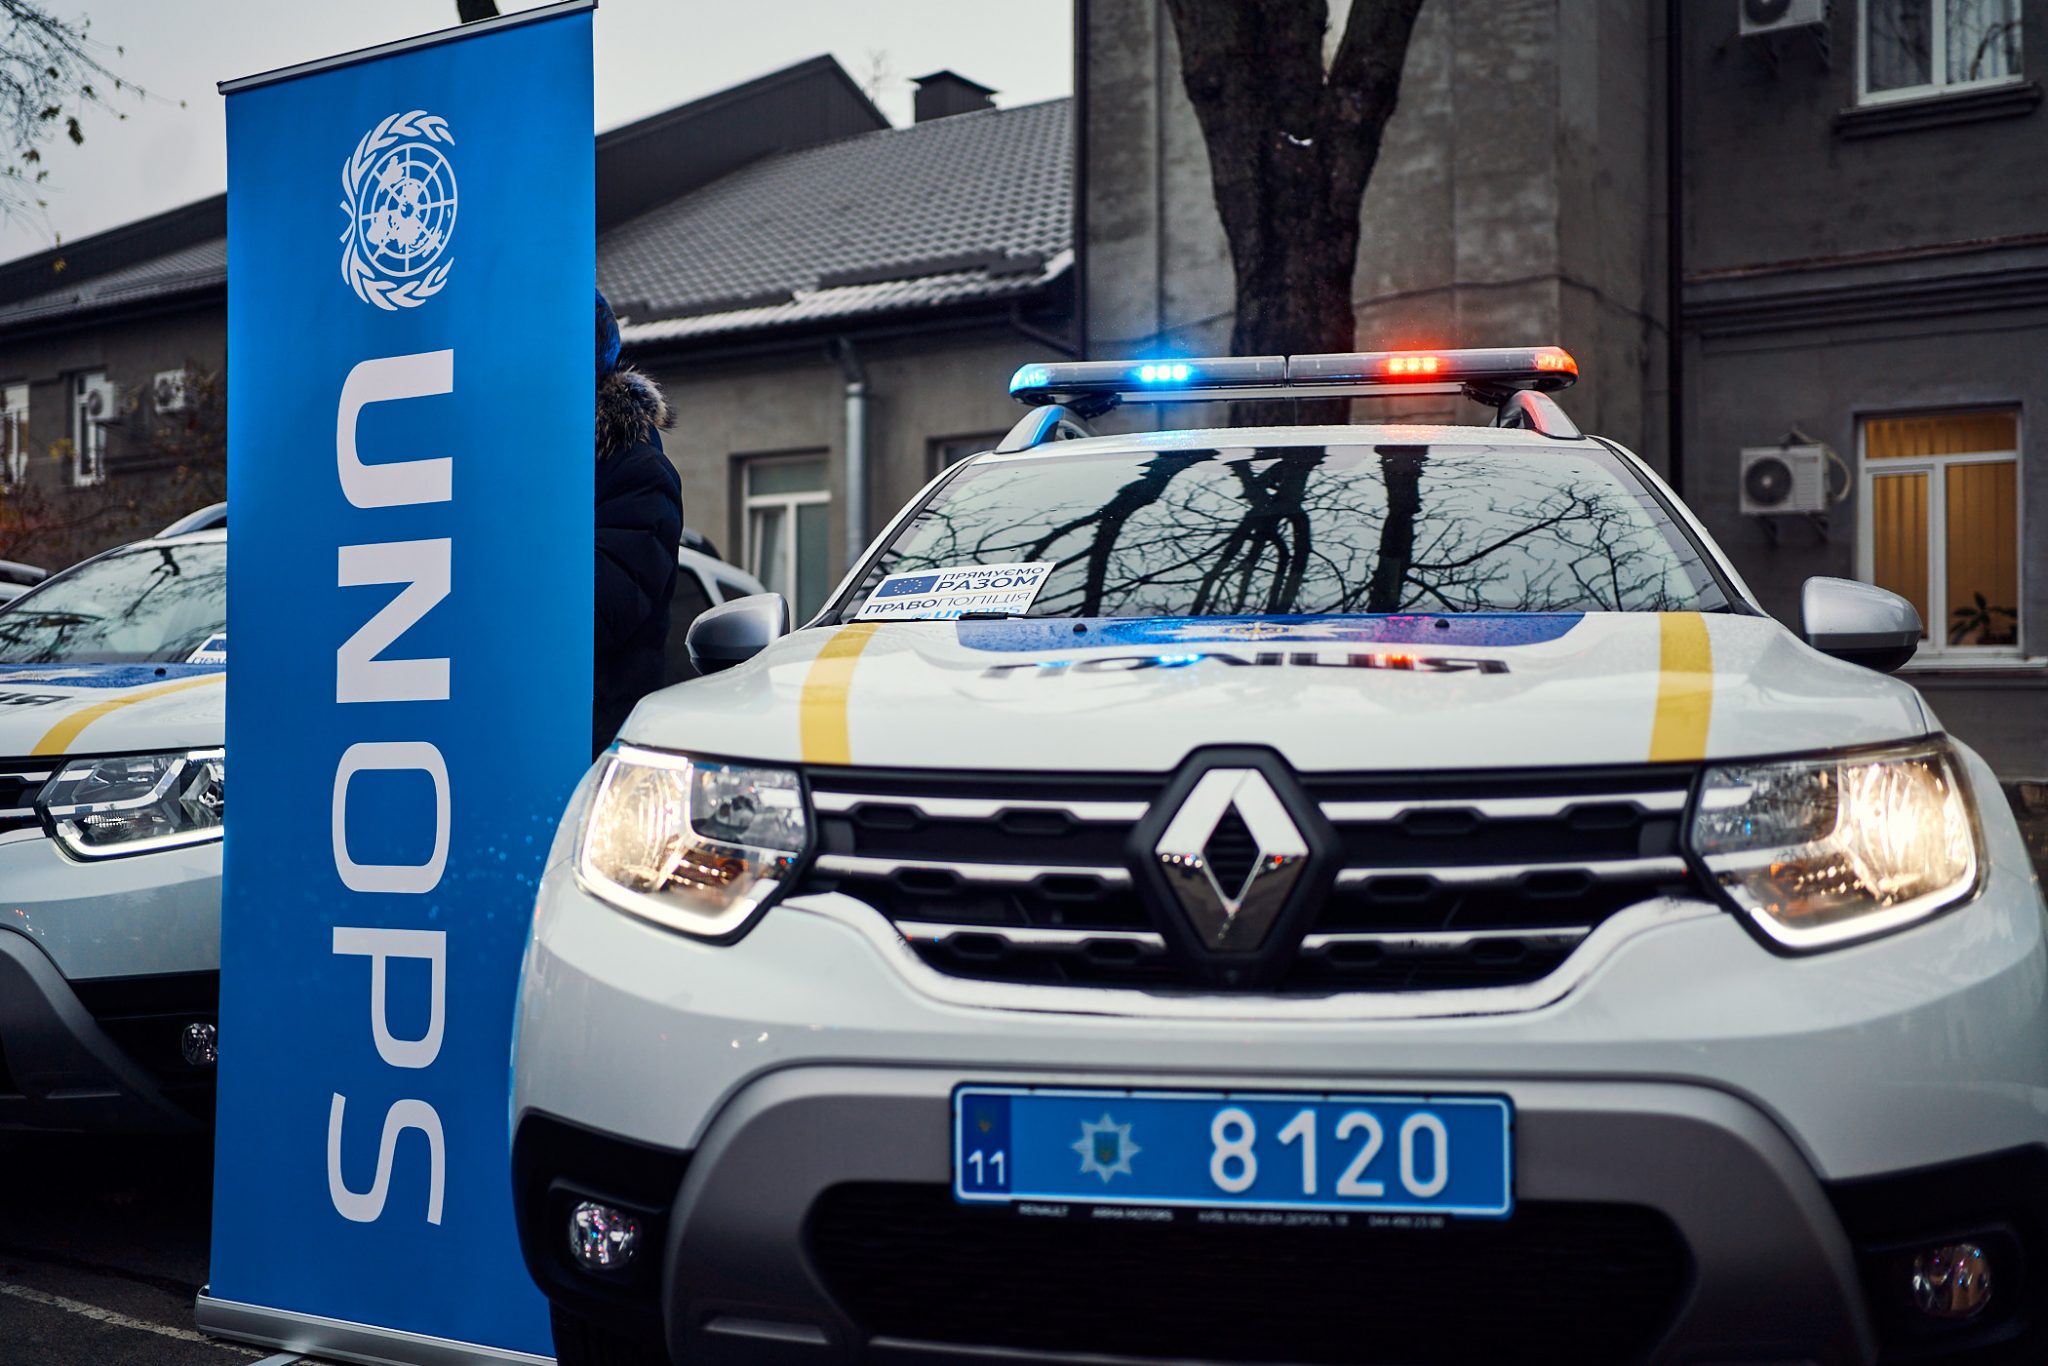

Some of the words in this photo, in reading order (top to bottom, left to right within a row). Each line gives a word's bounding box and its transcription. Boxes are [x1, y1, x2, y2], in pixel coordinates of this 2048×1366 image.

[935, 575, 1039, 592] РАЗОМ
[942, 567, 1045, 581] ПРЯМУЄМО
[865, 592, 1030, 614] ПРАВОПОЛІЦІЯ
[981, 652, 1511, 679] ПОЛІЦІЯ
[326, 349, 454, 1226] UNOPS
[1209, 1107, 1449, 1198] 8120
[967, 1150, 1005, 1186] 11
